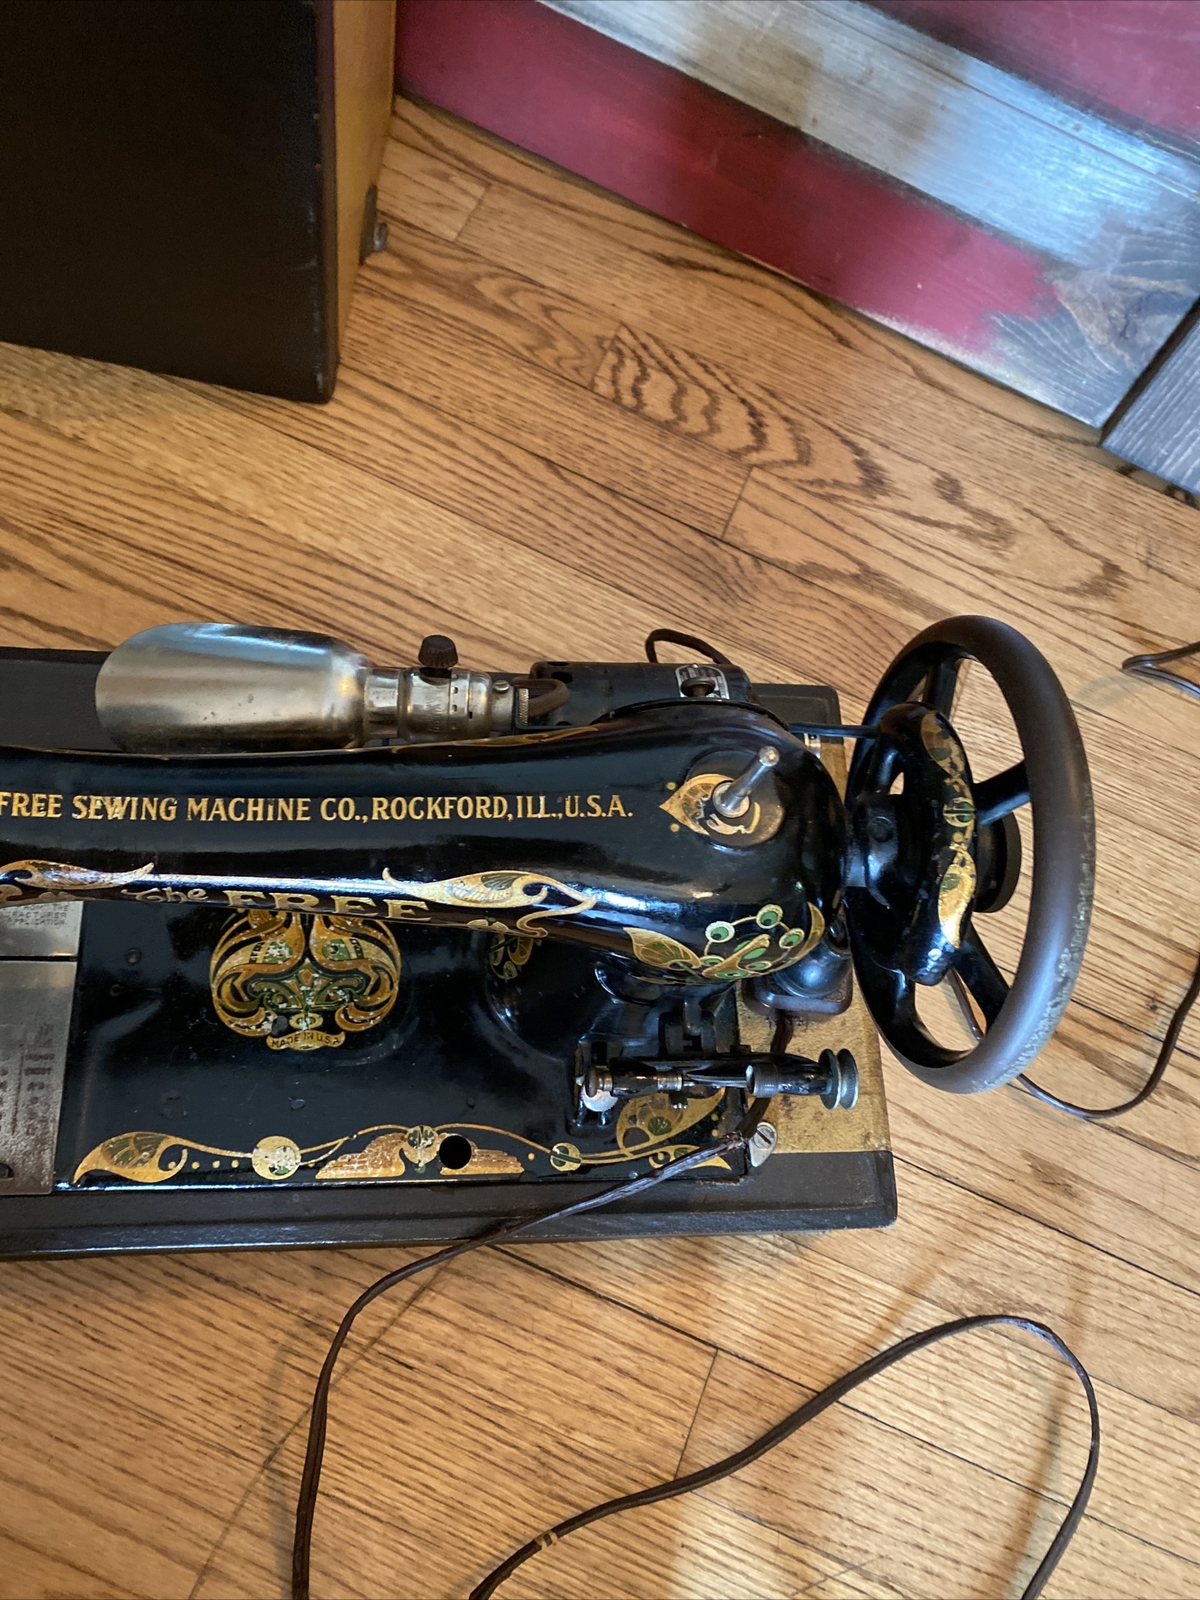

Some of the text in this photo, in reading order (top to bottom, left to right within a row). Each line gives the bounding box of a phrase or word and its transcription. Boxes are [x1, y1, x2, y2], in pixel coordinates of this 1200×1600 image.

[0, 791, 63, 818] FREE
[72, 795, 178, 820] SEWING
[187, 797, 311, 821] MACHINE
[565, 794, 633, 818] U.S.A.
[222, 889, 432, 922] FREE
[271, 1033, 301, 1048] MADE
[303, 1031, 314, 1040] IN
